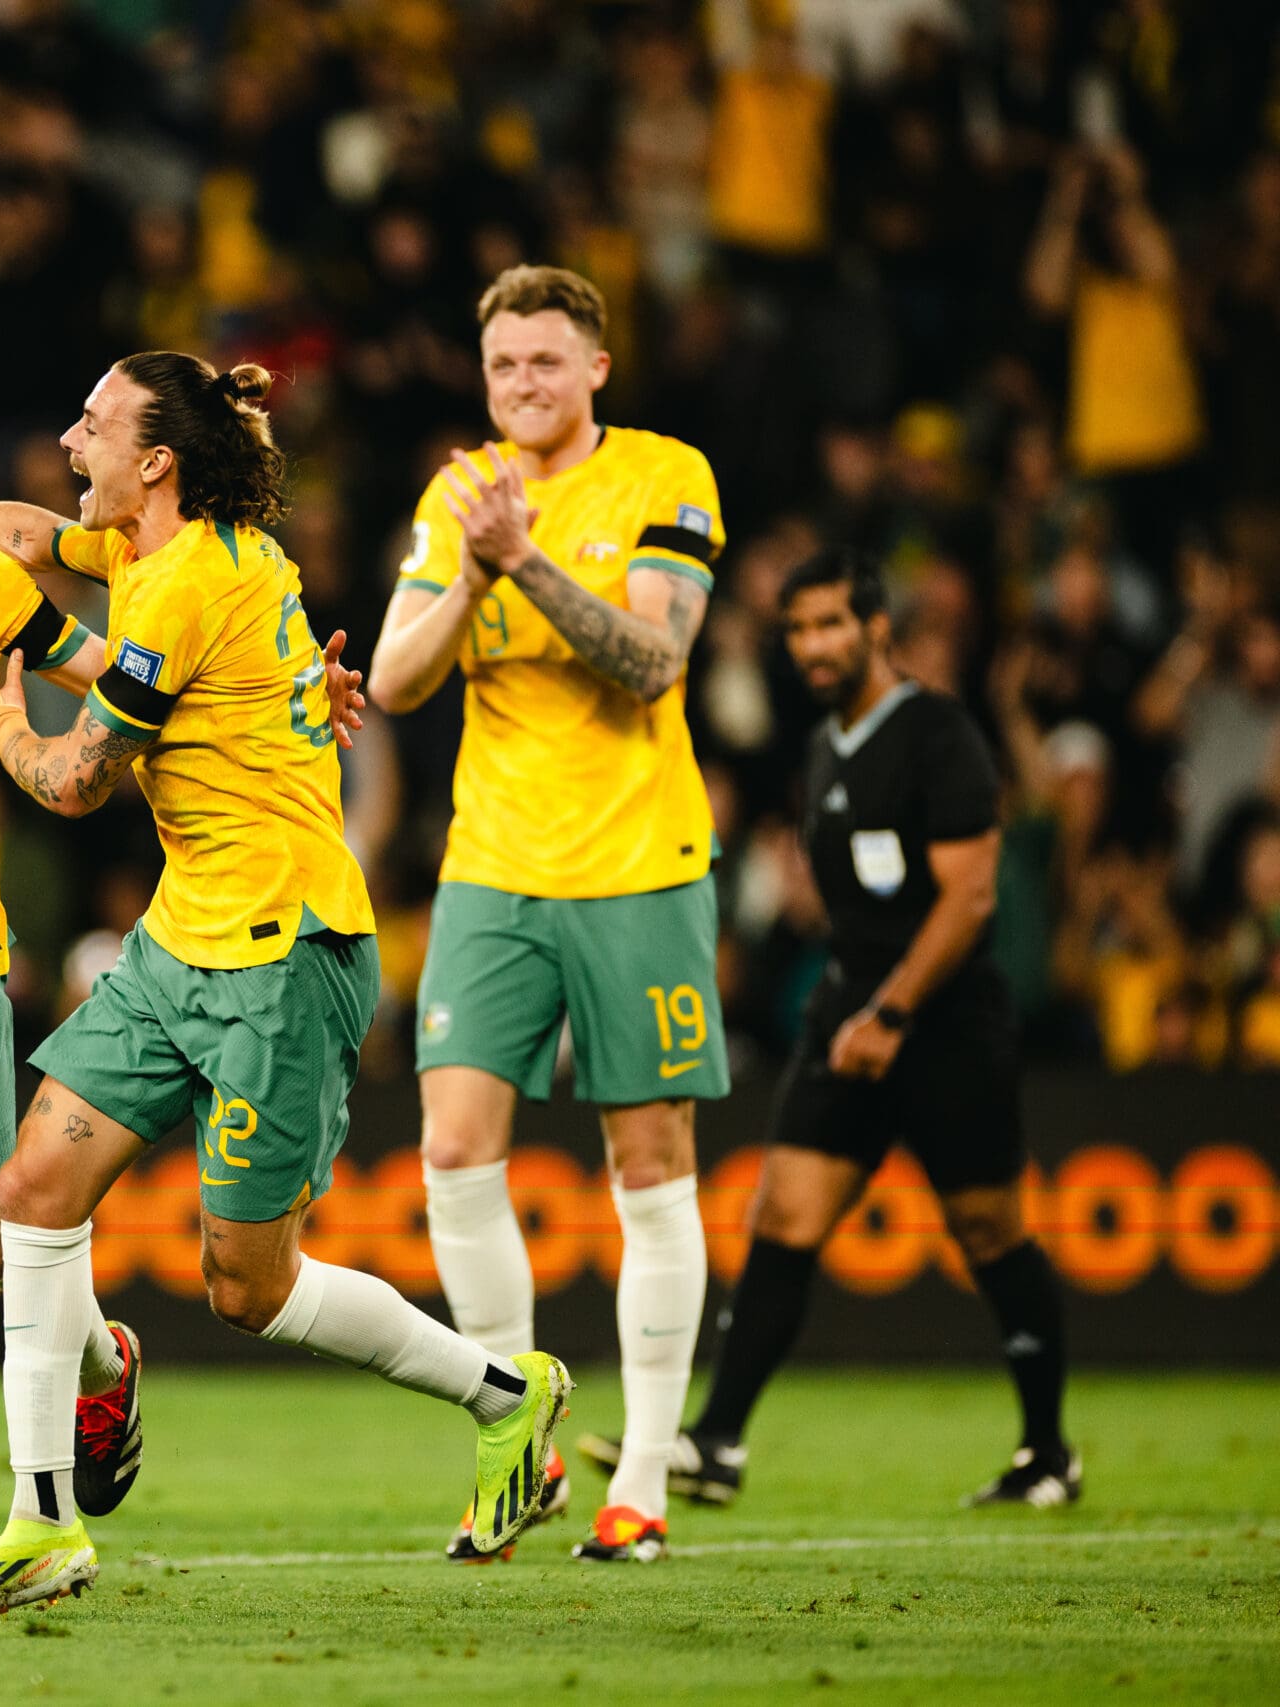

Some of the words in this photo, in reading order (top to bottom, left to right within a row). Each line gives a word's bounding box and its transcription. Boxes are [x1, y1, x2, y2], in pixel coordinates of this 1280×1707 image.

[123, 657, 151, 676] UNITES
[126, 649, 152, 666] FOOTBALL
[645, 983, 708, 1052] 19
